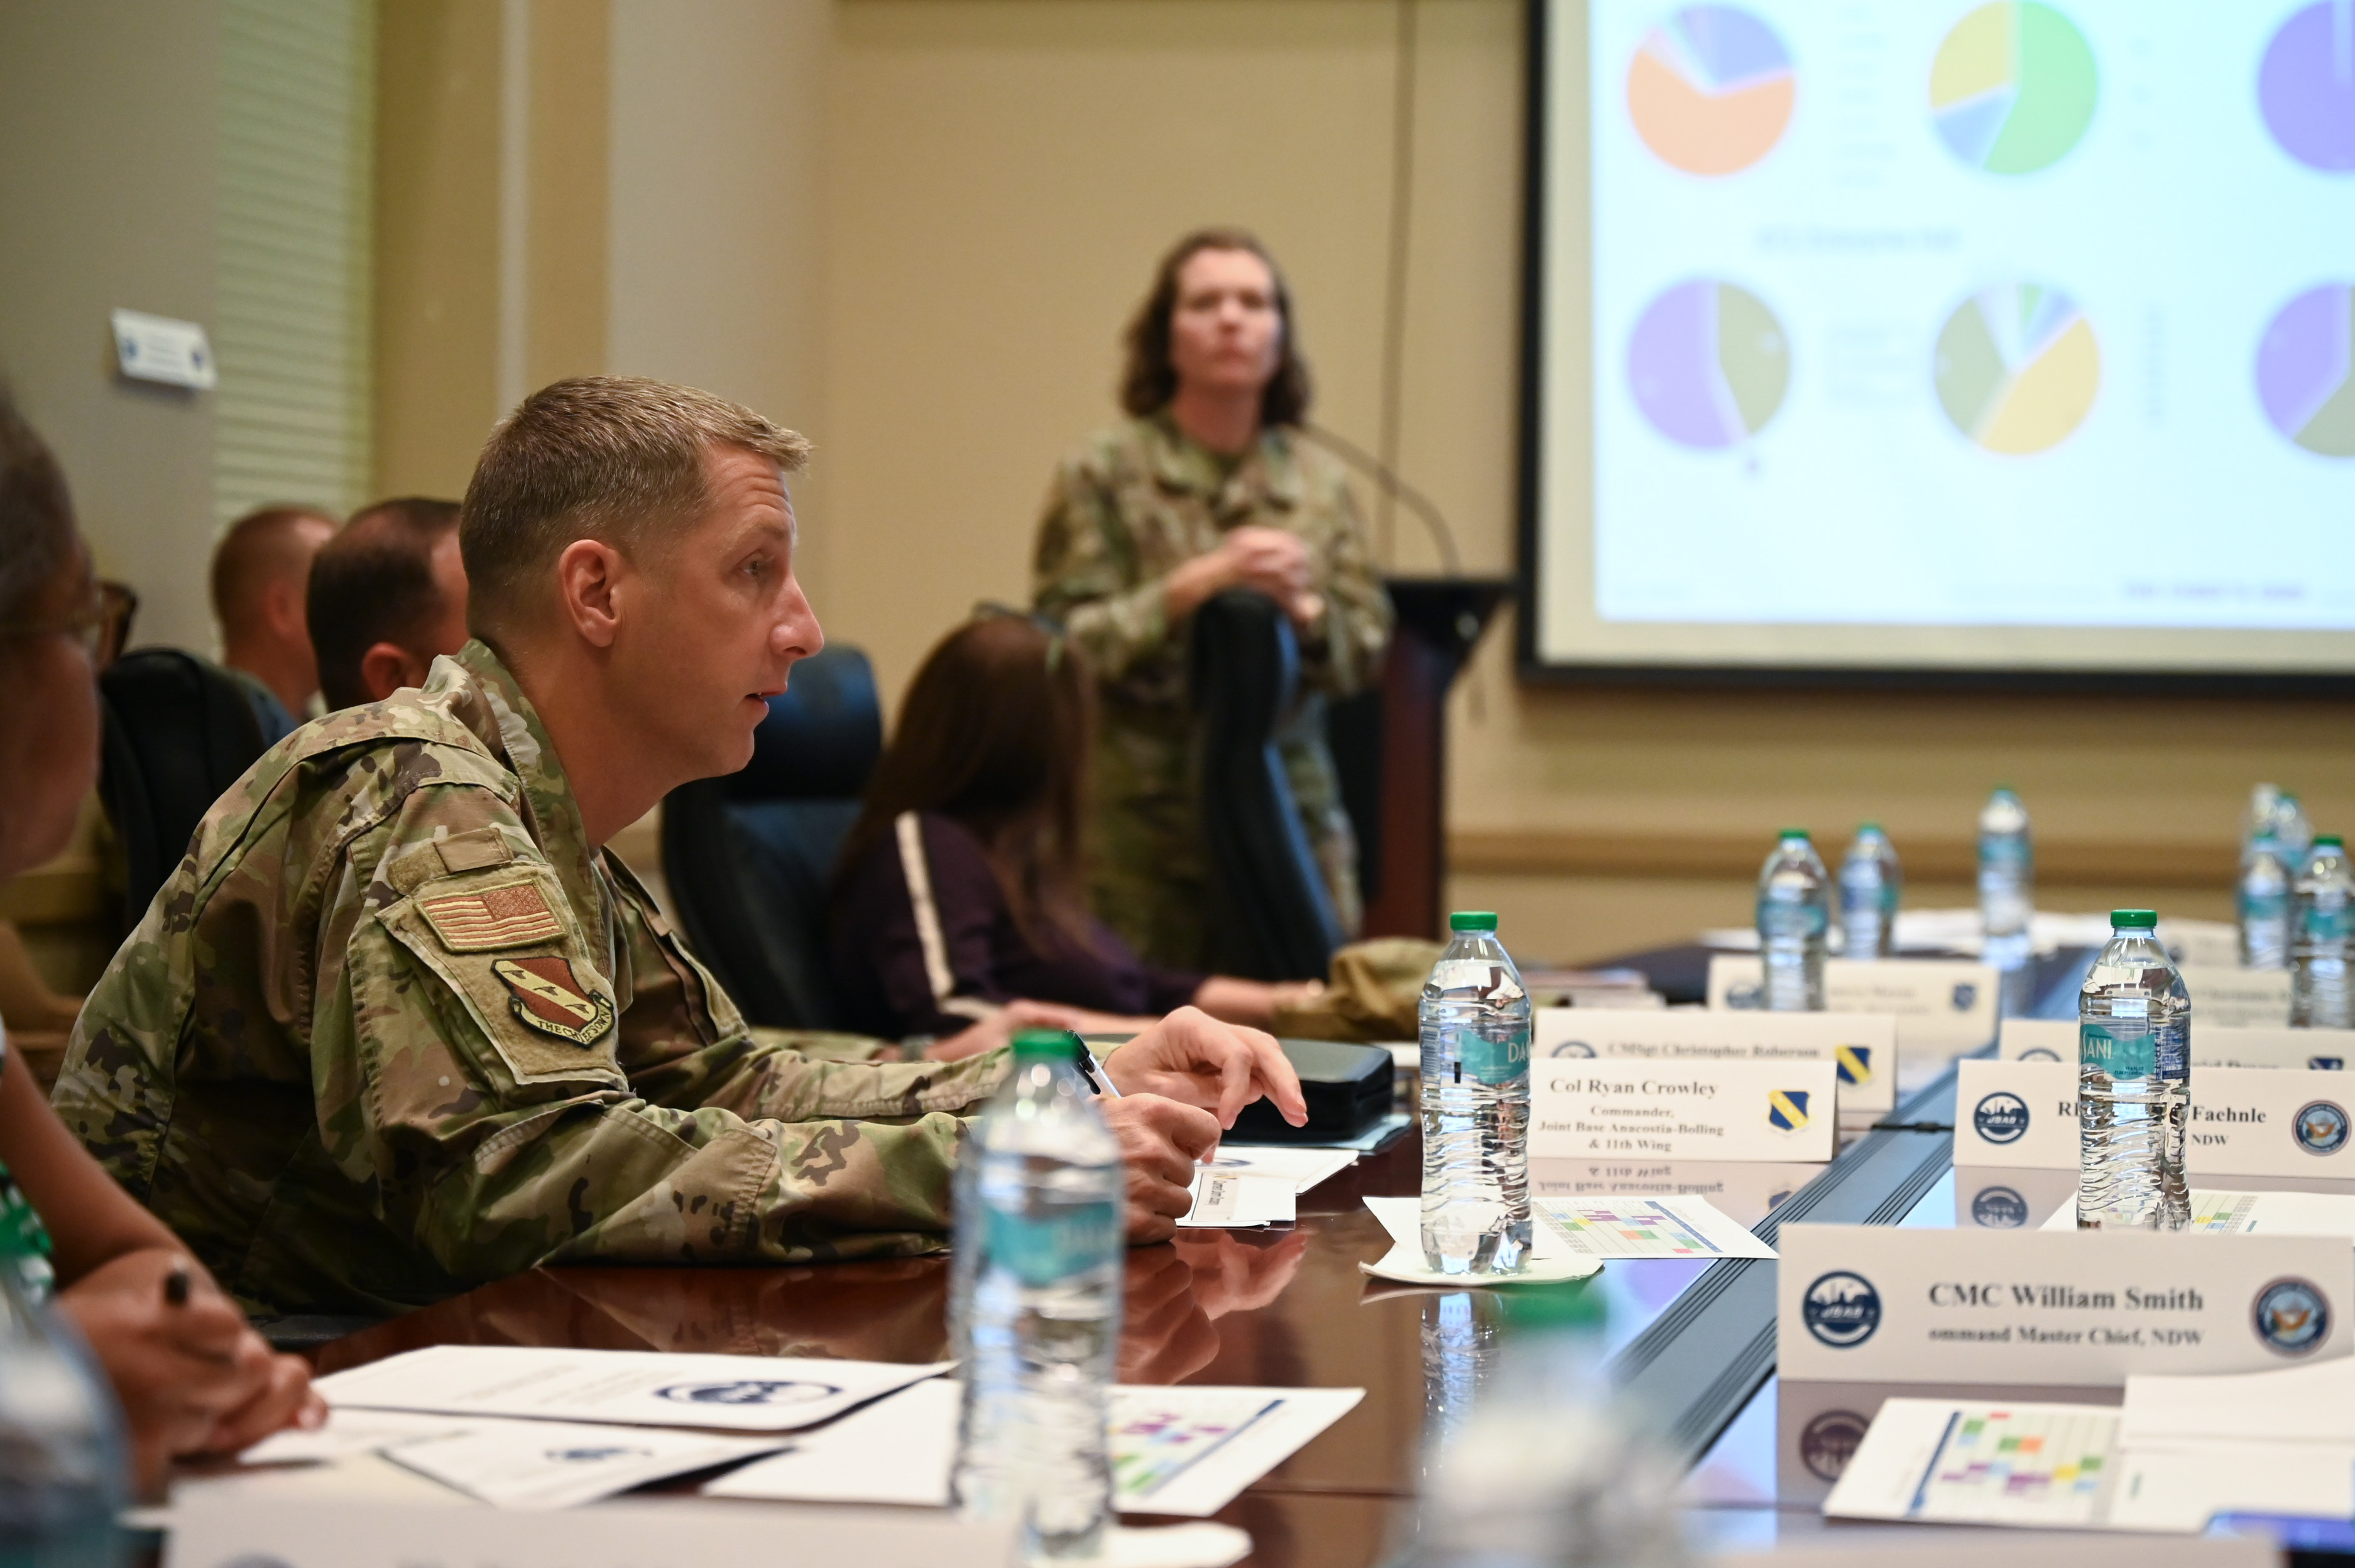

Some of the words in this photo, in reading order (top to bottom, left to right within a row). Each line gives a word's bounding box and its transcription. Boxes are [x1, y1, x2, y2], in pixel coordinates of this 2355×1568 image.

[537, 1020, 562, 1034] THE
[1662, 1043, 1747, 1059] Christopher
[1549, 1079, 1582, 1093] Col
[1588, 1079, 1634, 1097] Ryan
[1641, 1081, 1718, 1099] Crowley
[1590, 1106, 1675, 1118] Commander,
[2192, 1106, 2266, 1123] Faehnle
[1539, 1121, 1571, 1132] Joint
[1576, 1121, 1605, 1133] Base
[1611, 1123, 1724, 1137] Anacostia-Bolling
[1588, 1138, 1600, 1150] &
[1607, 1139, 1632, 1150] 11th
[1637, 1140, 1671, 1153] Wing
[2192, 1133, 2228, 1146] NDW
[1928, 1283, 2002, 1307] CMC
[2011, 1284, 2116, 1309] William
[2125, 1287, 2204, 1311] Smith
[2017, 1326, 2083, 1344] Master
[2087, 1327, 2146, 1346] Chief,
[2150, 1328, 2204, 1346] NDW
